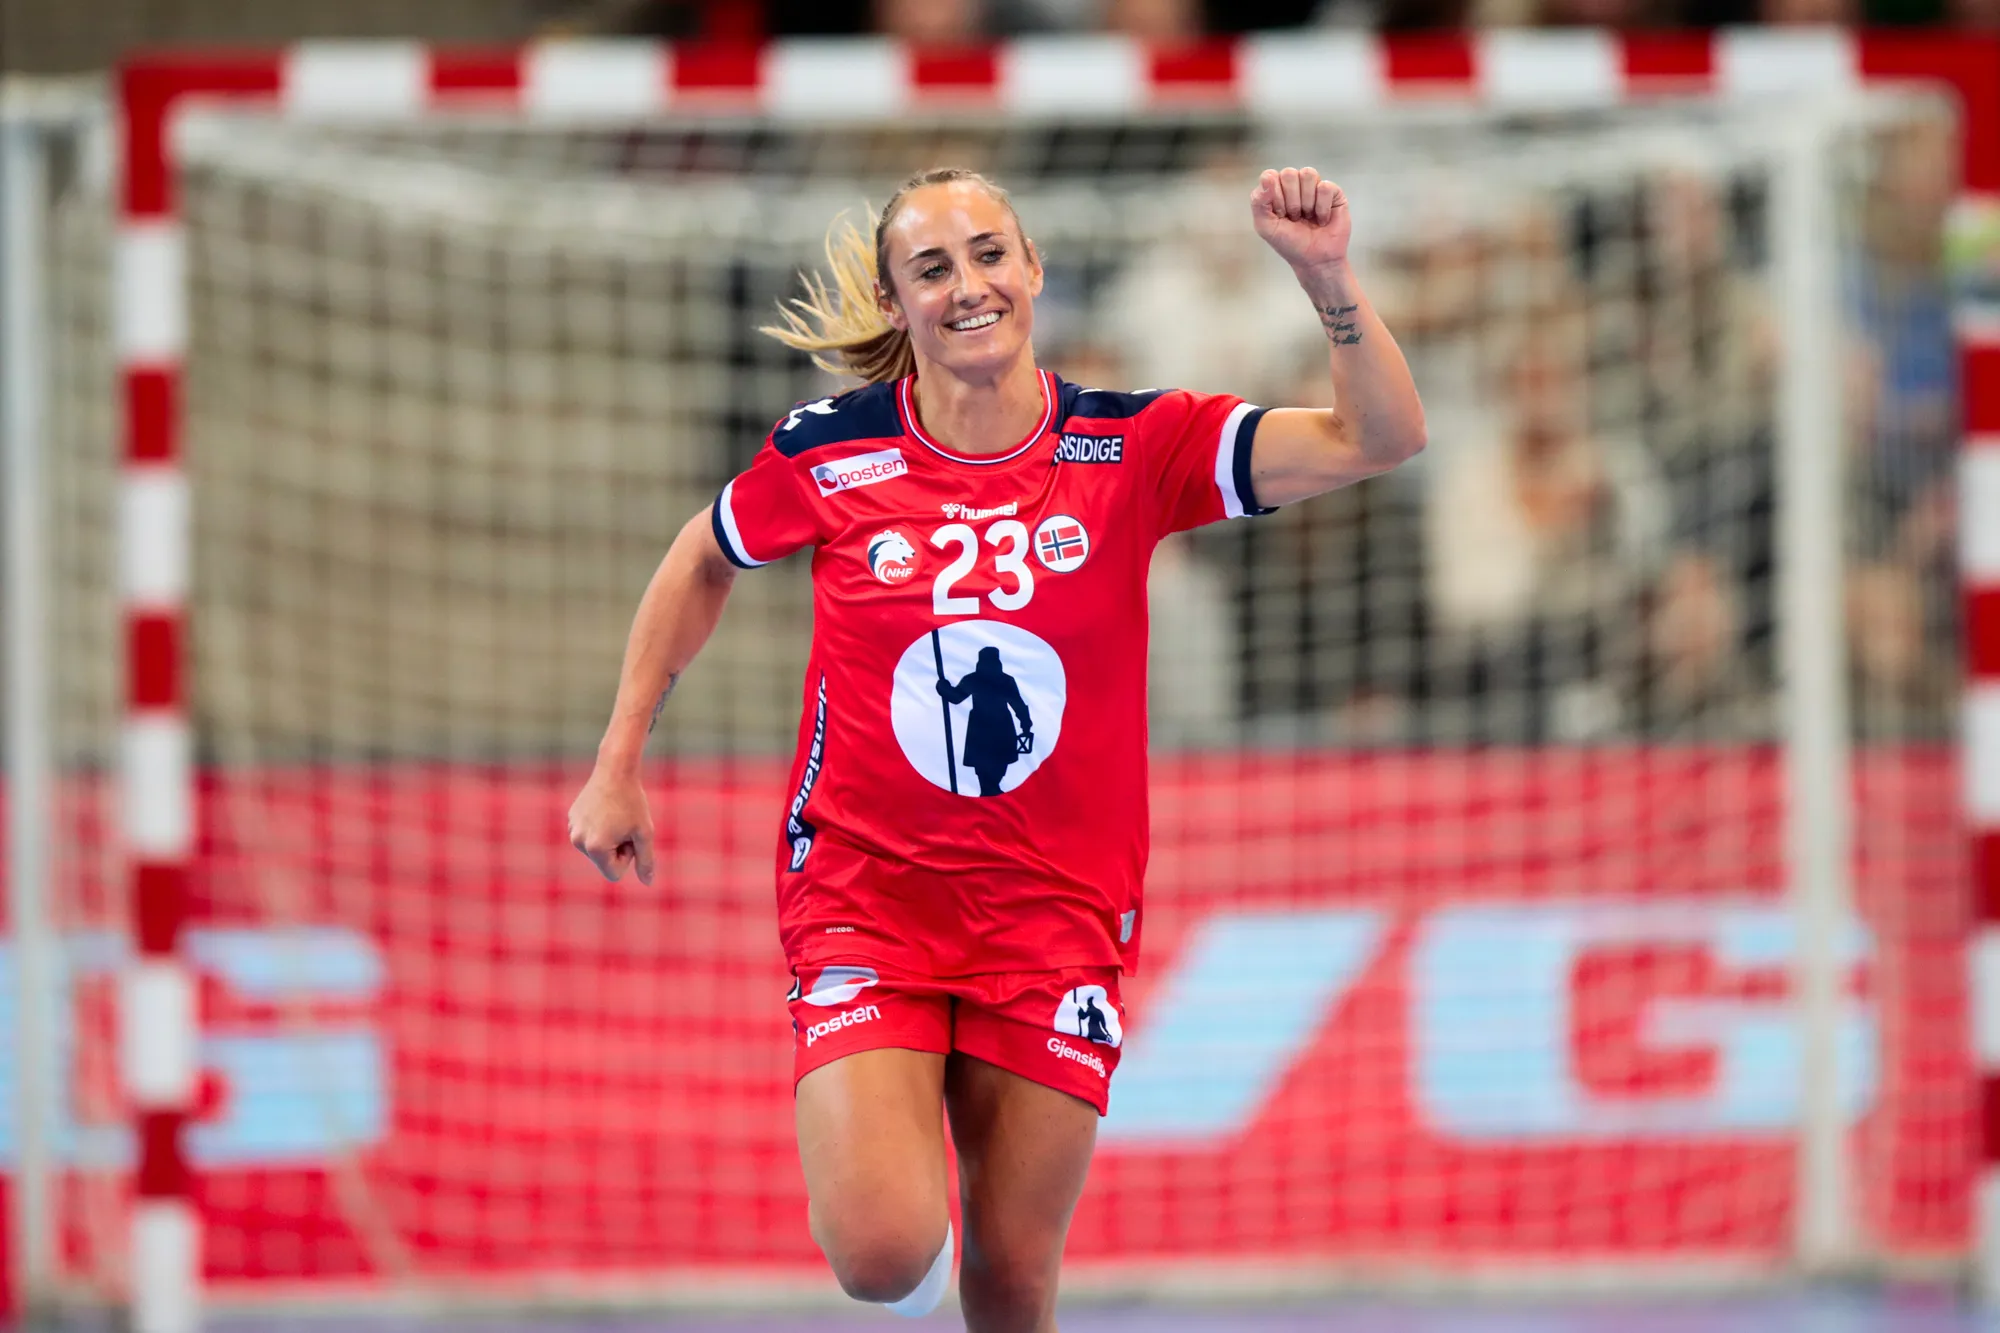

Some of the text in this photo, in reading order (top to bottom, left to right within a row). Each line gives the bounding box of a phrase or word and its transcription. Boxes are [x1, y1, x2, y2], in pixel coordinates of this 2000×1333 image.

[838, 459, 905, 488] posten
[960, 501, 1018, 520] hummel
[886, 567, 914, 578] NHF
[930, 519, 1035, 615] 23
[806, 1005, 882, 1048] posten
